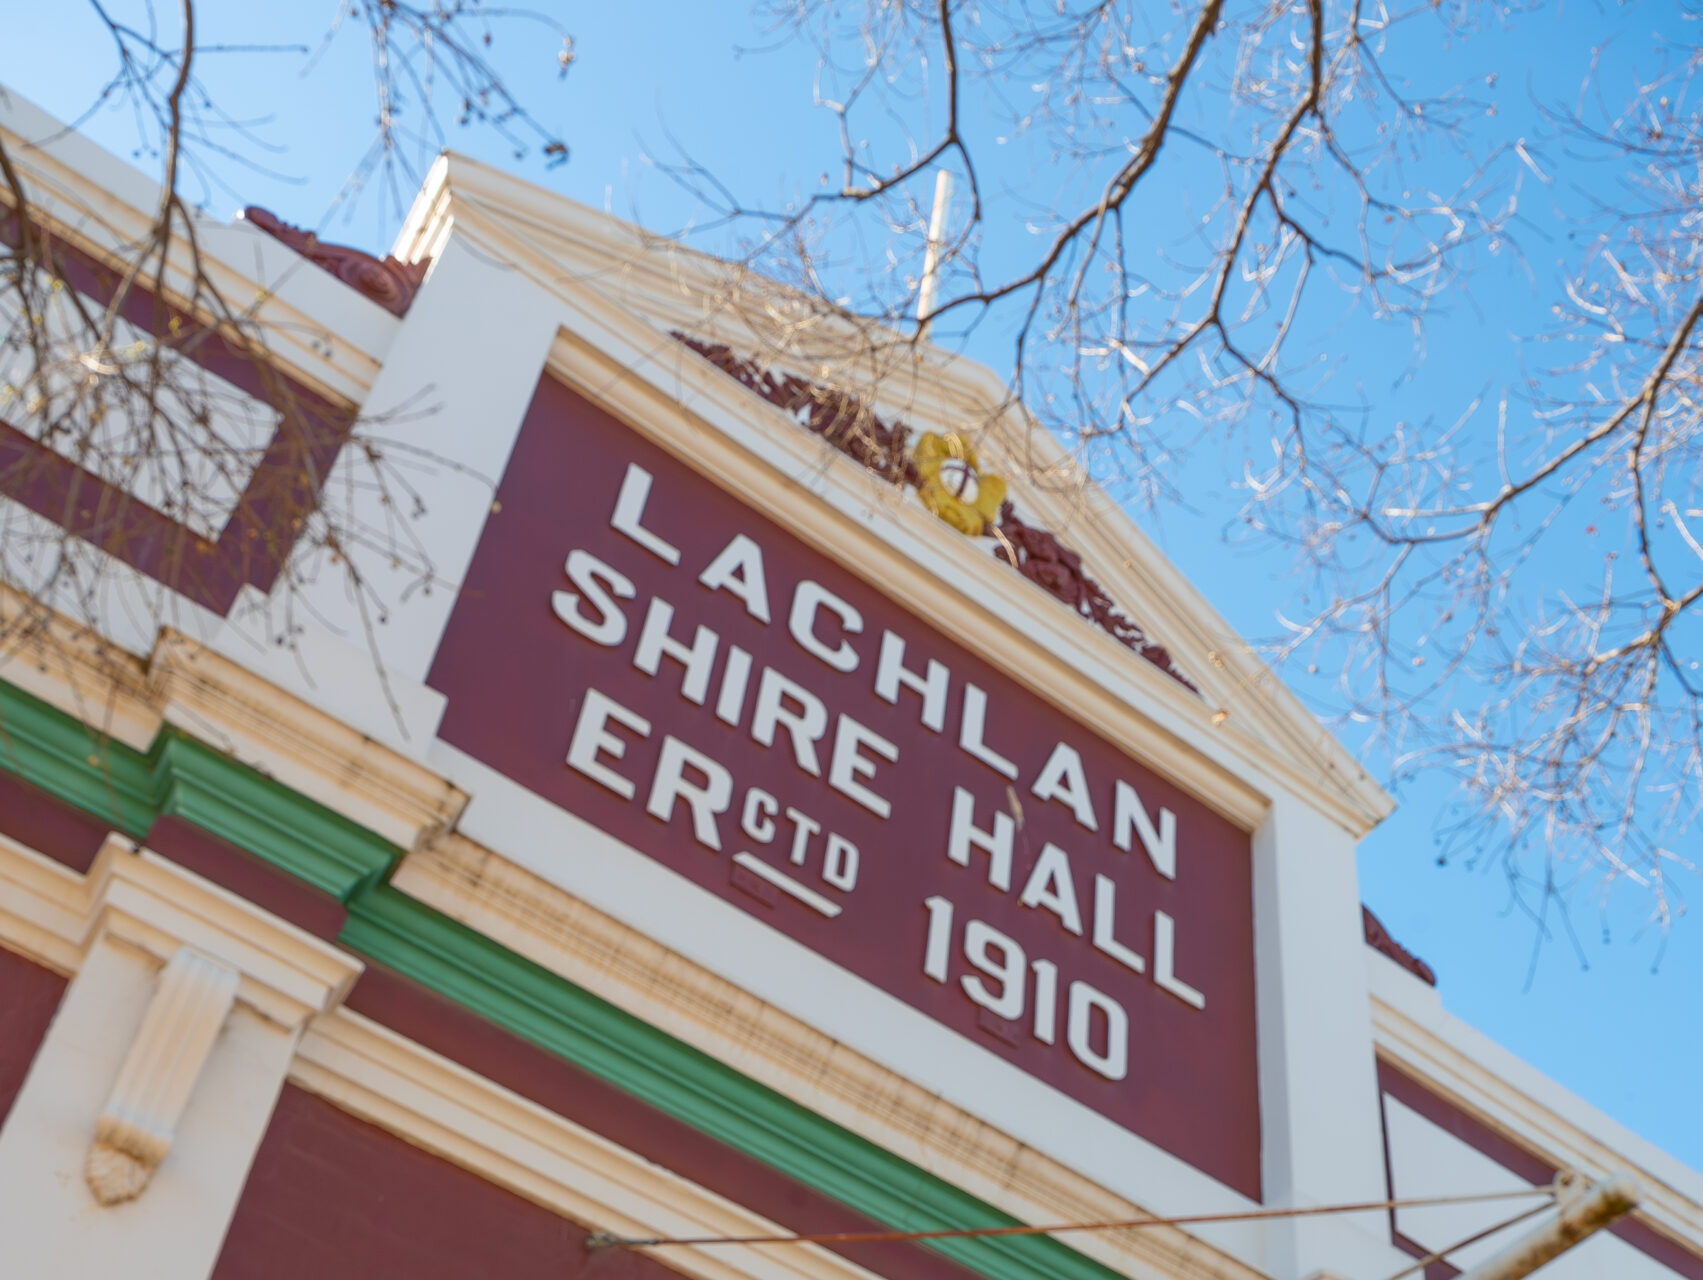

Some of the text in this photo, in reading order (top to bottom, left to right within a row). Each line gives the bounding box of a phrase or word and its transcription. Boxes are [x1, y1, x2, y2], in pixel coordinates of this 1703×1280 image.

[551, 549, 1206, 1010] SHIRE HALL
[610, 462, 1177, 880] LACHLAN
[924, 895, 1129, 1080] 1910
